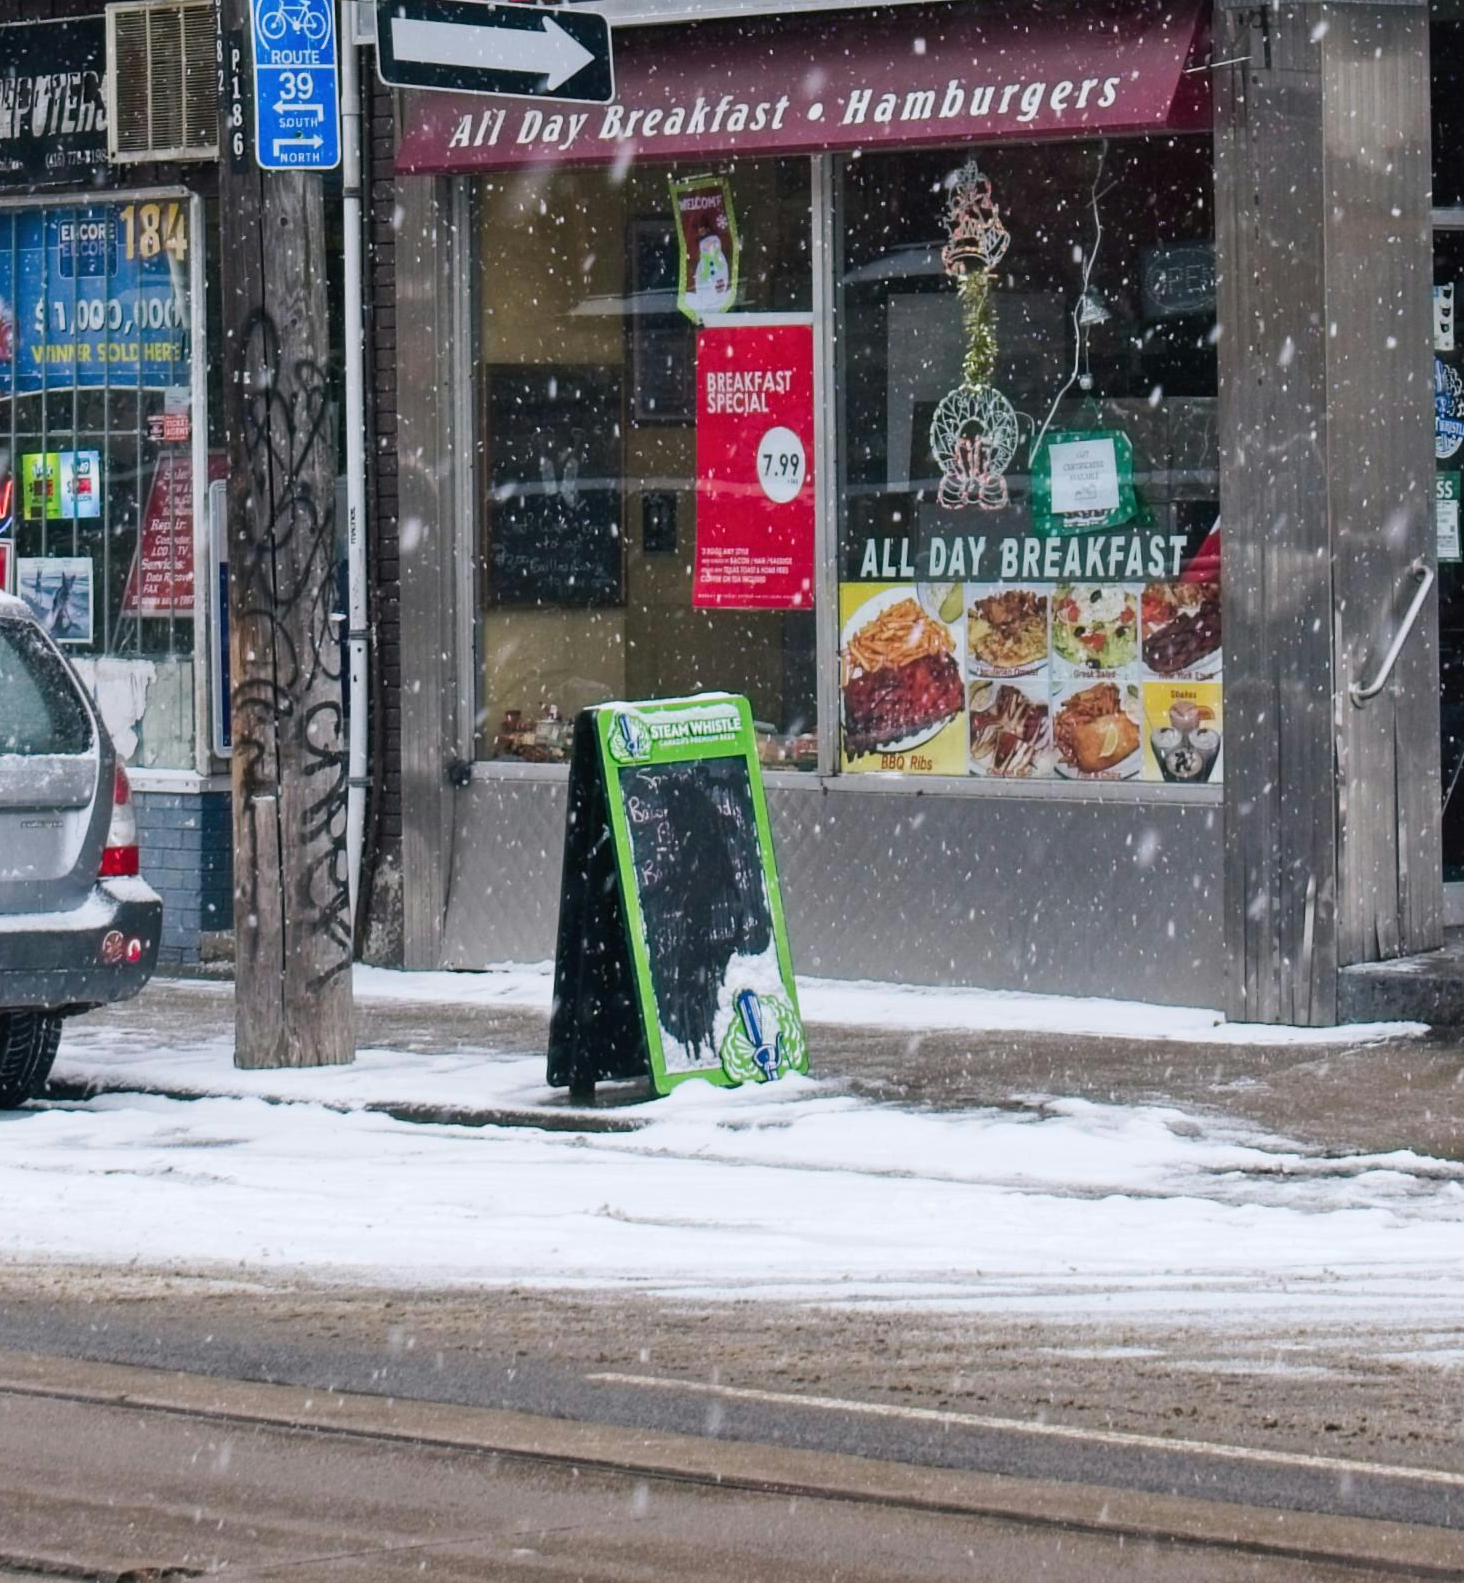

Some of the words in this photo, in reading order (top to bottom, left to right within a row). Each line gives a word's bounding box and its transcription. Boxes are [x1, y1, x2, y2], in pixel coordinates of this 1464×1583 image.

[271, 49, 320, 65] ROUTE
[279, 72, 313, 100] 39
[449, 108, 506, 149] All
[516, 101, 583, 147] Day
[599, 100, 788, 140] Breakfast
[842, 72, 1122, 128] Hamburgers
[278, 117, 318, 128] SOUTH
[280, 152, 320, 163] NORTH
[120, 203, 188, 261] 184
[98, 341, 139, 362] SOLD
[706, 370, 792, 393] BREAKFAST
[706, 392, 769, 414] SPECIAL
[762, 453, 800, 477] 7.99
[860, 536, 915, 578] ALL
[929, 535, 986, 577] DAY
[1000, 534, 1188, 579] BREAKFAST
[1170, 689, 1197, 700] Shakes
[650, 721, 692, 740] STEAM
[693, 717, 742, 735] WHISTLE
[880, 754, 904, 771] BBQ
[909, 754, 933, 771] Ribs
